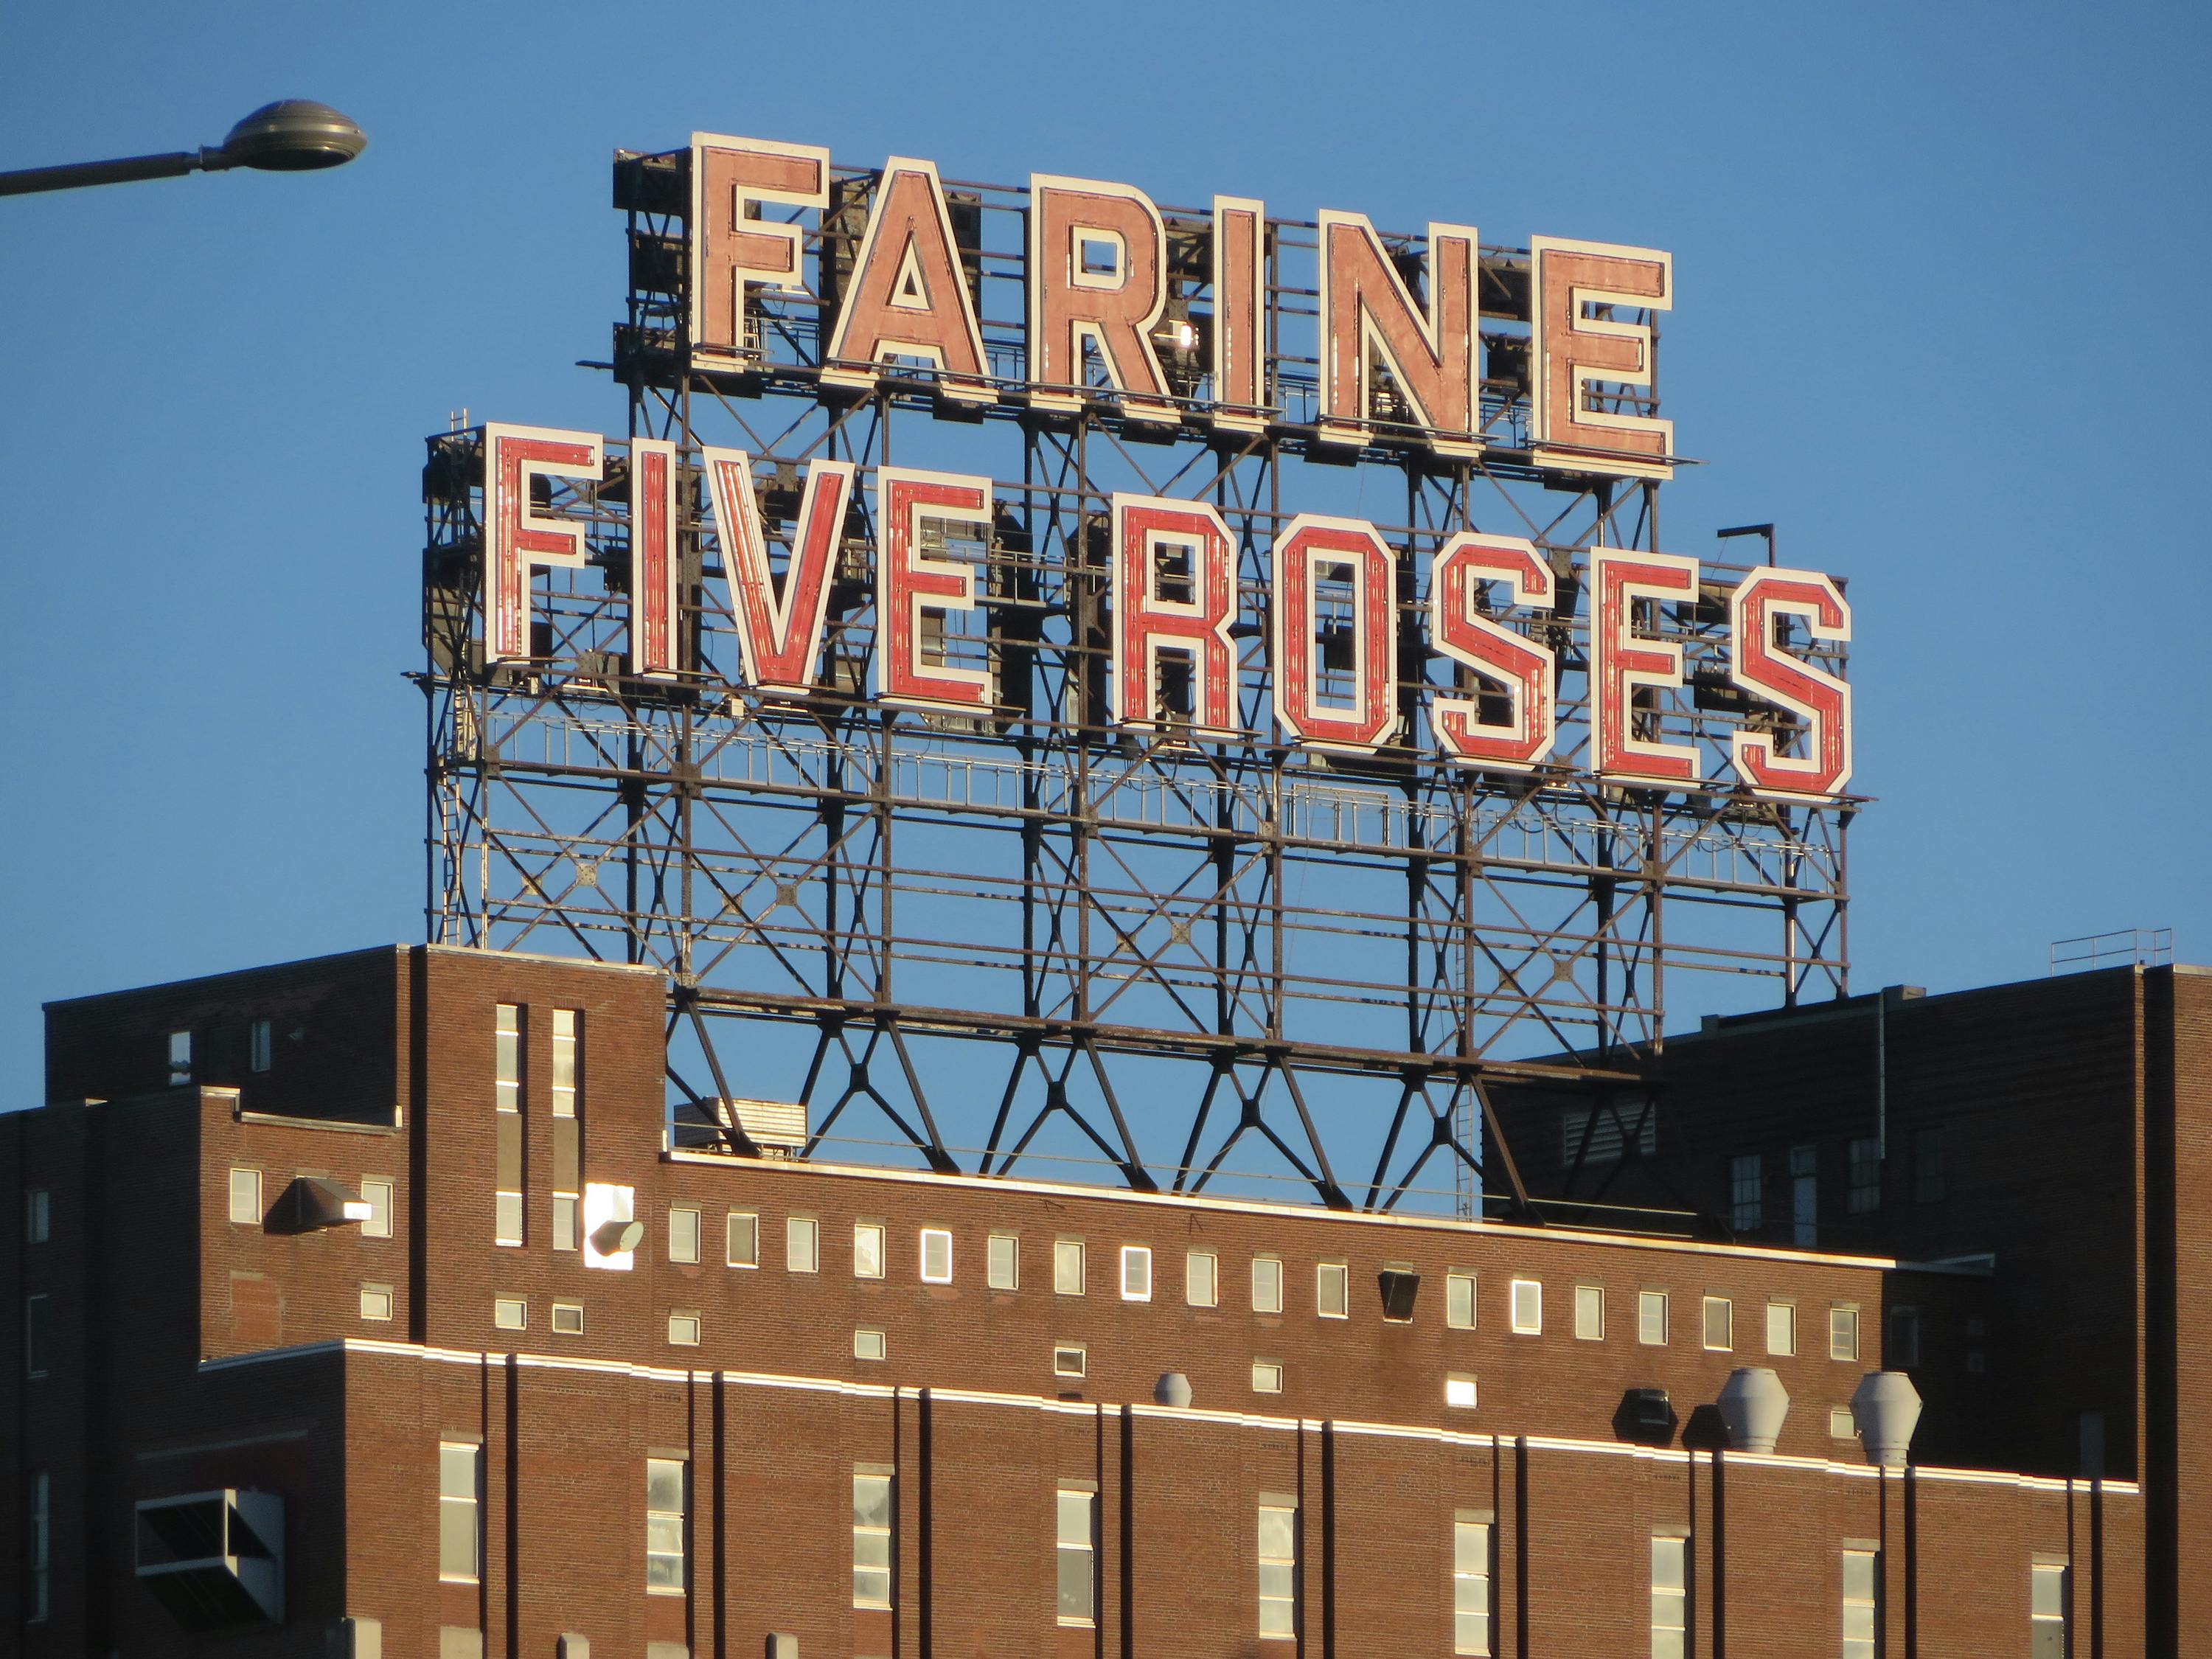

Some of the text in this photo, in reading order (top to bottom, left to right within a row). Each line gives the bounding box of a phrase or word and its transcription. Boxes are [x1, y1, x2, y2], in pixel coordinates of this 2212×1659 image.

[691, 131, 1673, 480] FARINE
[486, 422, 1851, 802] FIVE ROSES
